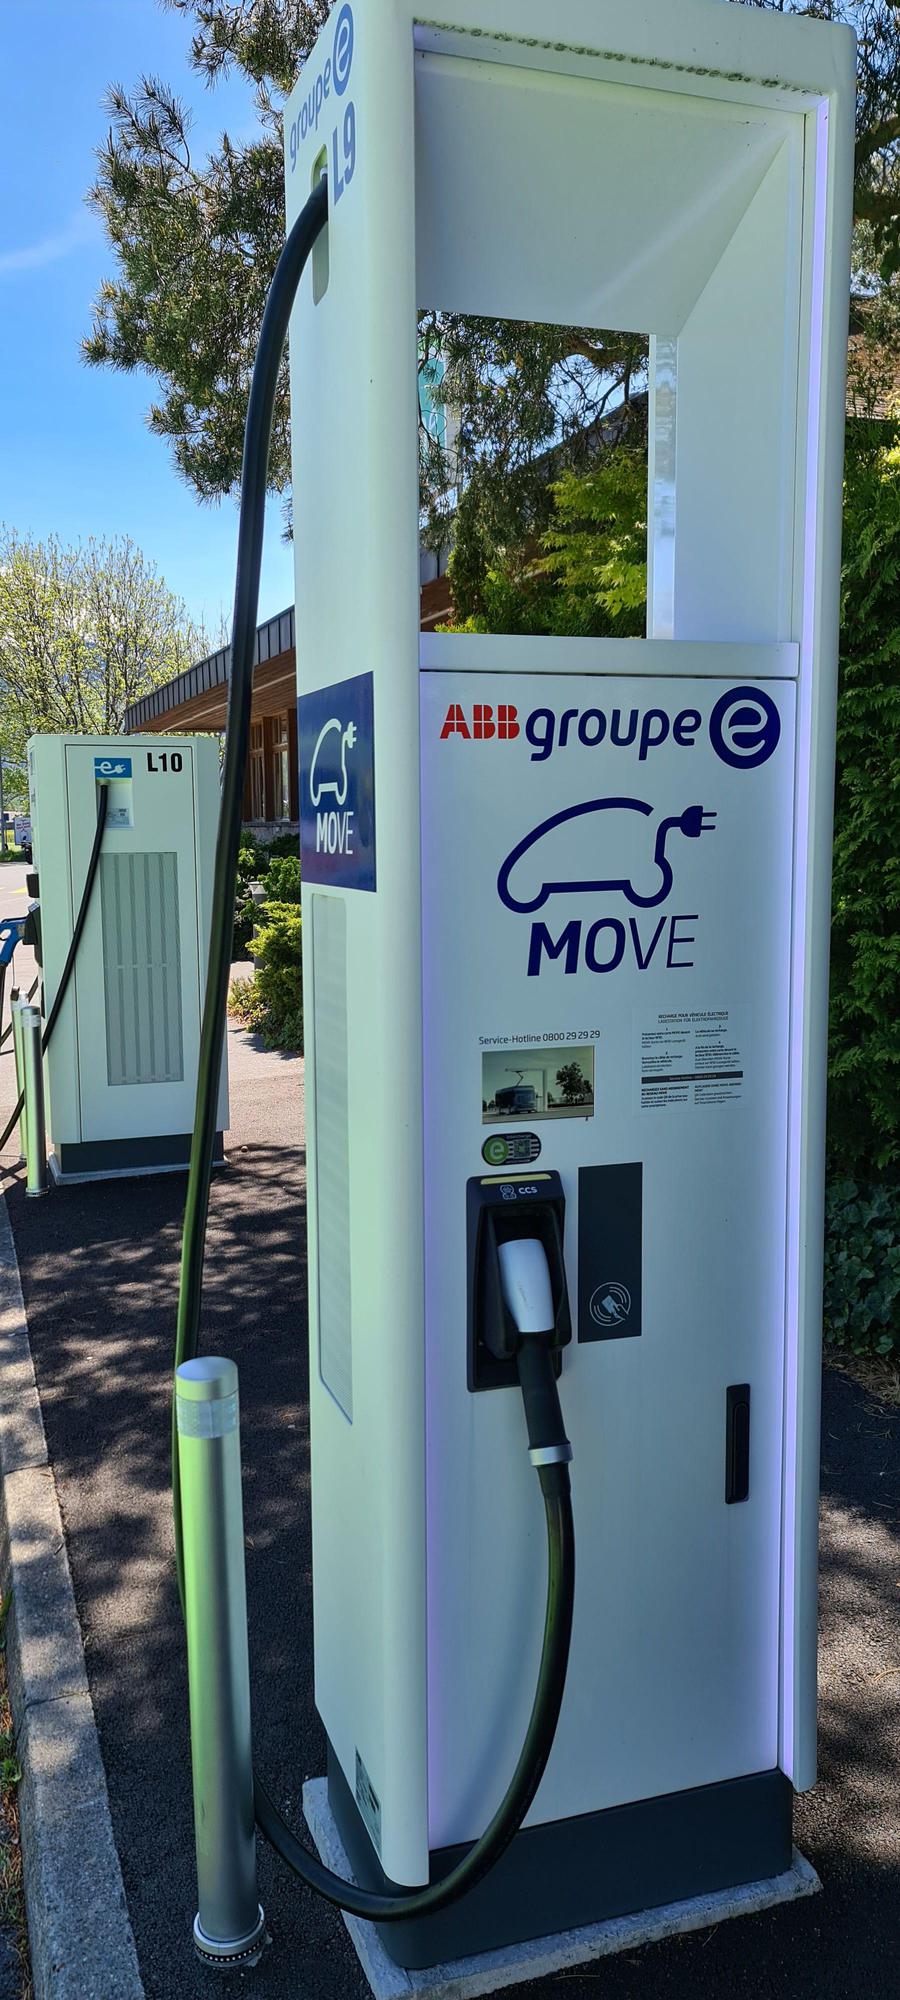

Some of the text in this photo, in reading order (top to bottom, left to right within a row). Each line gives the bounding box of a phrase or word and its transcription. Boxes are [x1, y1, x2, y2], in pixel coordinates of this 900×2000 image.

[289, 57, 332, 173] groupe
[332, 101, 356, 207] L9
[439, 703, 520, 739] ABB
[525, 707, 703, 762] groupe
[147, 752, 183, 773] L10
[316, 811, 354, 855] MOVE
[526, 914, 699, 977] MOVE
[479, 1030, 600, 1045] Service-Hotline 0800 29 29 29
[518, 1186, 538, 1194] CCS
